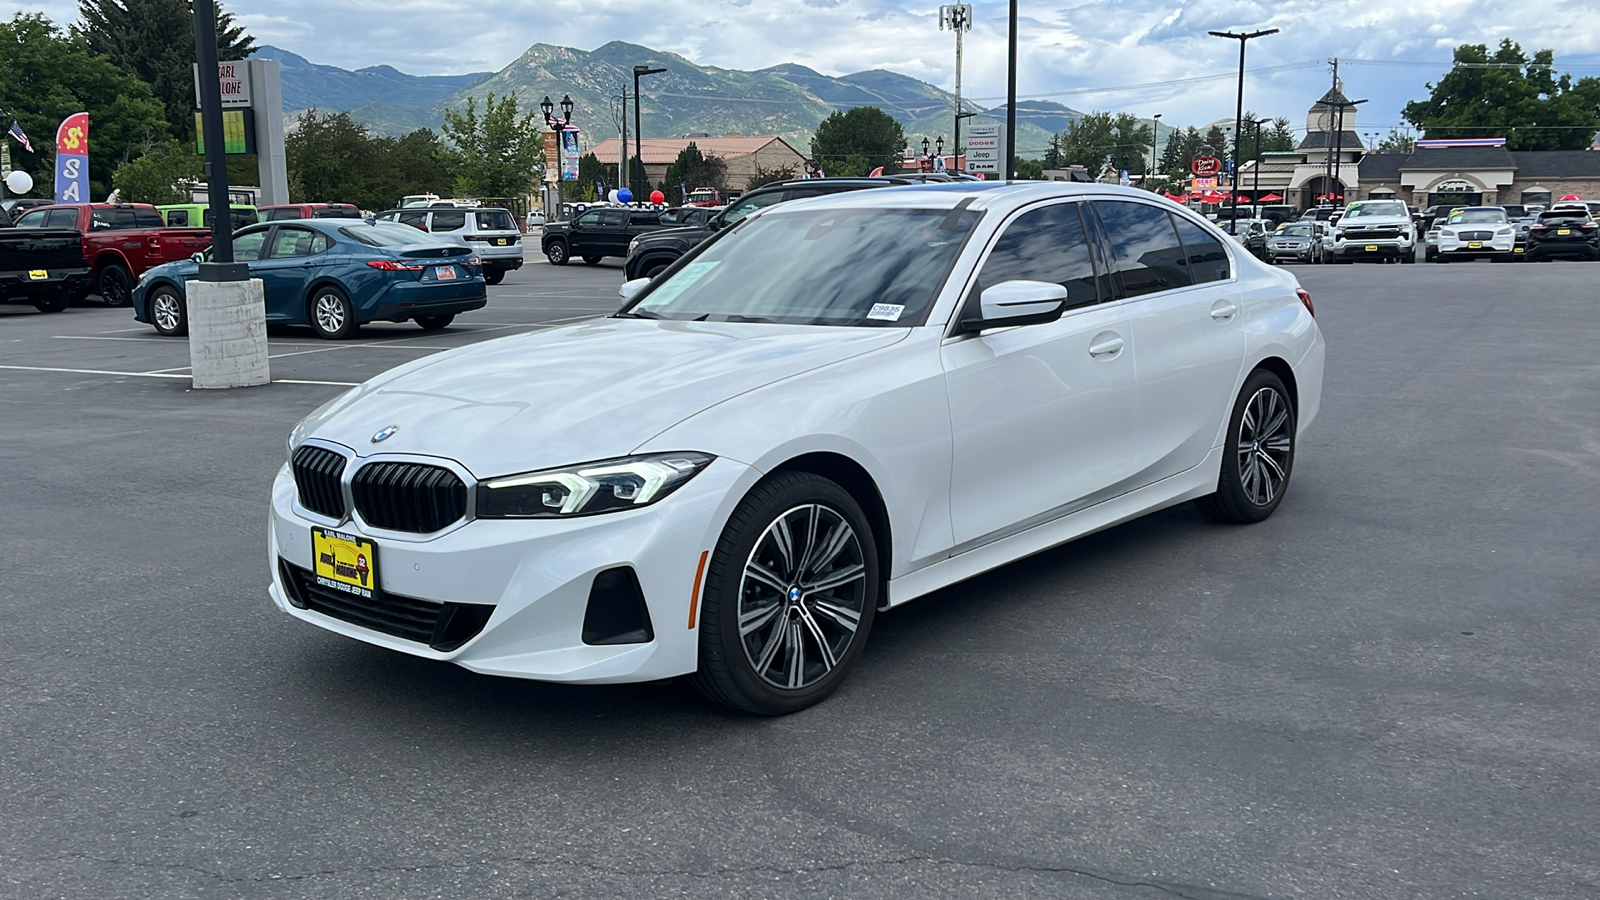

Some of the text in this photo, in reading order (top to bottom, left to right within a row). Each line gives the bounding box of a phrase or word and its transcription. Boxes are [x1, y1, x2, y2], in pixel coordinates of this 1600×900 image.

[220, 81, 242, 95] LONE
[972, 151, 990, 159] Jeep
[873, 304, 901, 312] C9835
[324, 529, 356, 542] KARL MALONE
[358, 557, 366, 568] 32
[316, 576, 372, 598] CHRYSLER DODGE JEEP RAM
